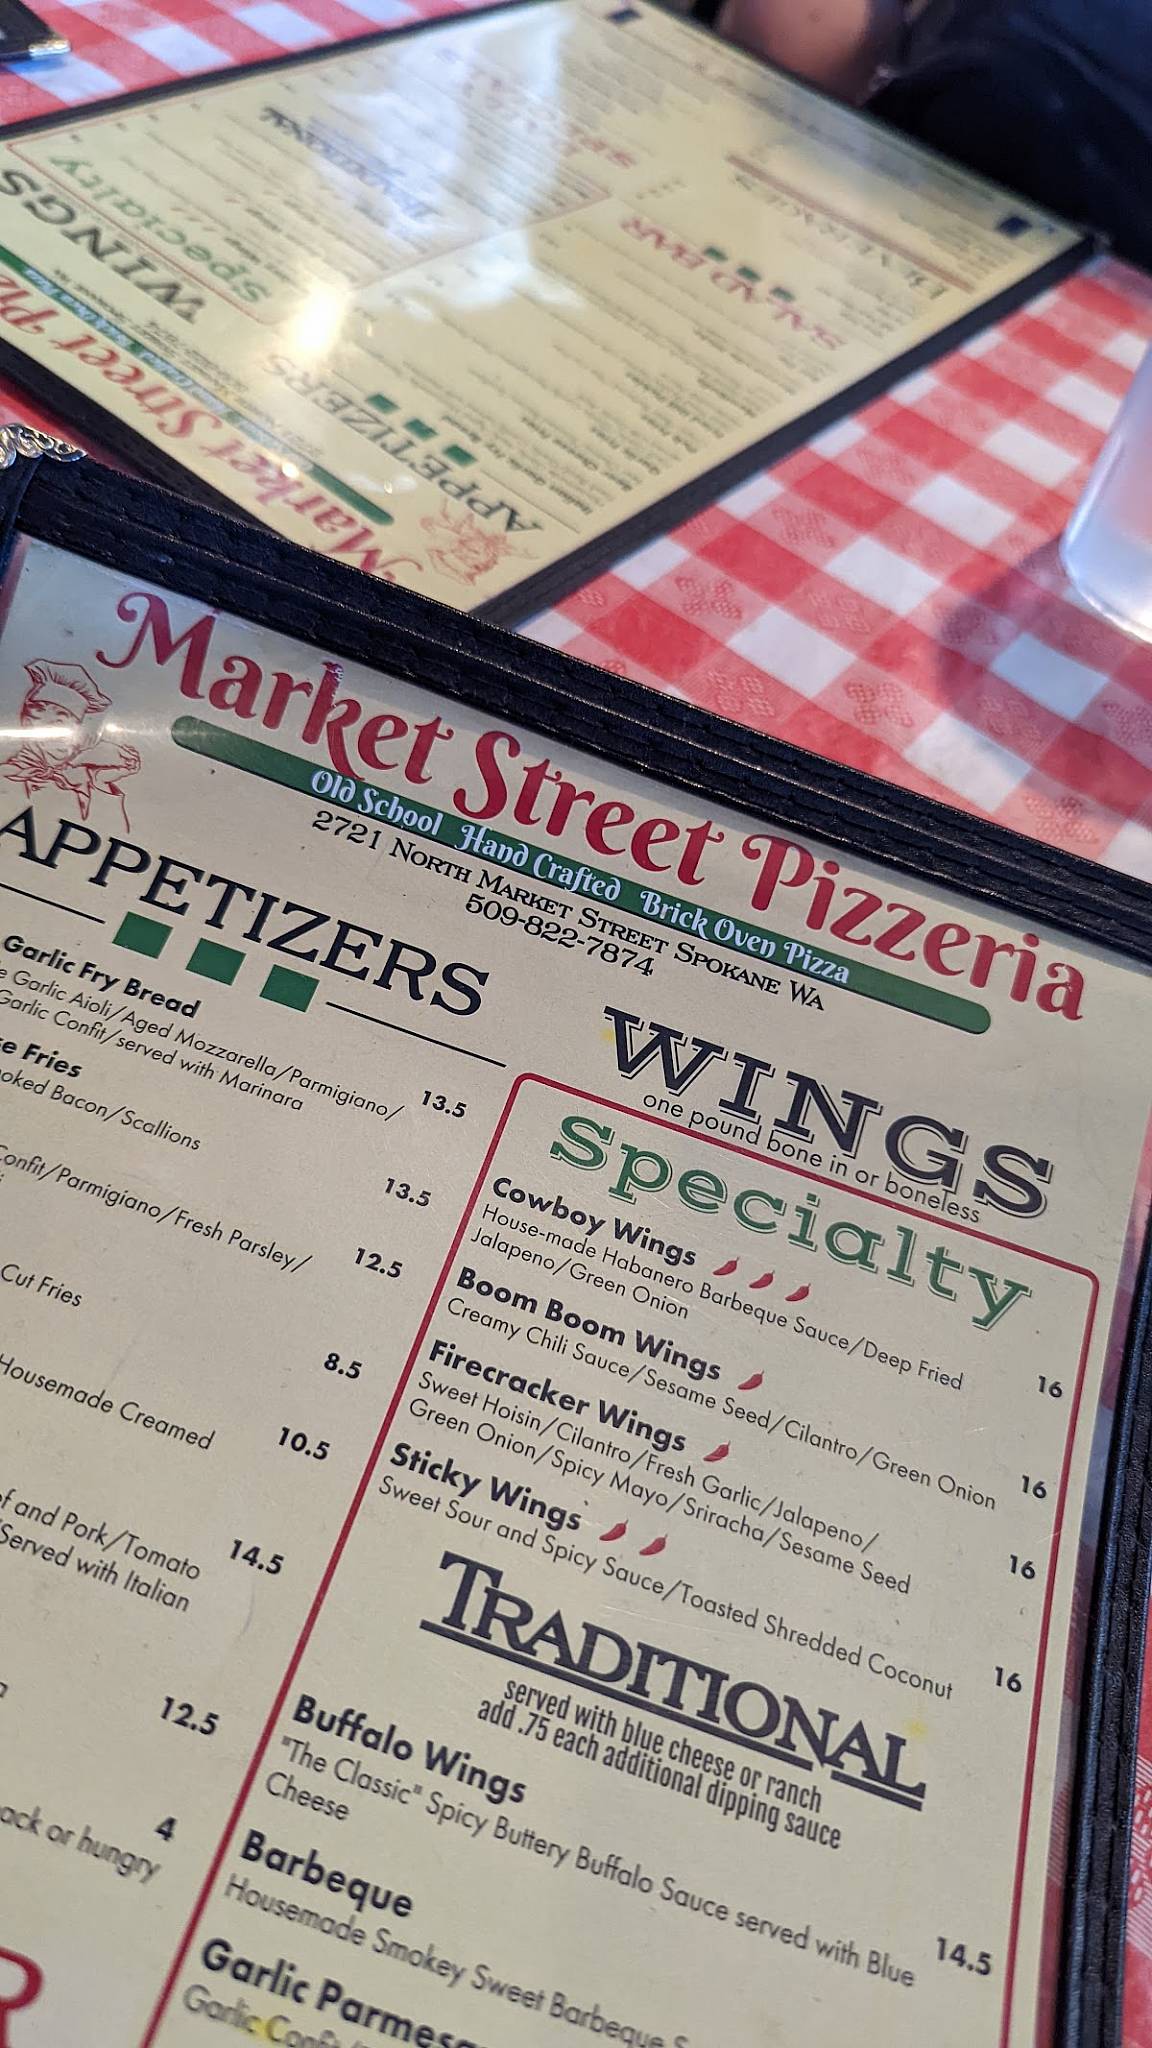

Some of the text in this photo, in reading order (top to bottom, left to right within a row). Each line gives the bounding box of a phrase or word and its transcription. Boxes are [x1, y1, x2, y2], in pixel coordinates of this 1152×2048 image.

[0, 167, 207, 324] WINGS
[48, 153, 272, 306] Specialty
[50, 334, 223, 440] Street
[264, 354, 545, 533] APPETIZERS
[206, 428, 425, 581] Market
[96, 592, 1086, 1021] Market Street Pizzeria
[0, 806, 490, 1017] APPETIZERS
[312, 769, 851, 984] Old School Hand Crafted Brick Oven Pizza
[0, 935, 202, 1019] Garlic Fry Bread
[465, 893, 655, 978] 509-822-7874
[13, 970, 67, 1002] Garlic
[0, 989, 50, 1021] Garlic
[180, 1059, 215, 1080] with
[218, 1070, 304, 1112] Marinara
[0, 1069, 51, 1096] oked
[21, 1043, 83, 1079] Fries
[422, 1090, 467, 1119] 13.5
[603, 1005, 1055, 1219] WINGS
[385, 1178, 432, 1208] 13.5
[643, 1094, 980, 1223] one pound bone in or boneless
[355, 1248, 404, 1279] 12.5
[493, 1177, 697, 1267] Cowboy Wings
[549, 1115, 1031, 1330] Specialty
[0, 1264, 83, 1308] Cut Fries
[456, 1266, 721, 1382] Boom Boom Wings
[482, 1204, 597, 1259] House-made
[602, 1247, 694, 1294] Habanero
[699, 1282, 788, 1328] Barbeque
[918, 1360, 964, 1391] Fried
[632, 1286, 689, 1320] Onion
[0, 1353, 216, 1451] Housemade Creamed
[324, 1353, 363, 1380] 8.5
[418, 1371, 479, 1408] Sweet
[429, 1339, 687, 1453] Firecracker Wings
[447, 1298, 522, 1342] Creamy
[526, 1327, 569, 1356] Chili
[938, 1475, 996, 1511] Onion
[1038, 1376, 1064, 1399] 16
[278, 1427, 331, 1461] 10.5
[390, 1443, 582, 1532] Sticky Wings
[1022, 1475, 1048, 1500] 16
[14, 1502, 62, 1528] and
[409, 1398, 470, 1436] Green
[860, 1561, 912, 1595] Seed
[77, 1558, 119, 1586] with
[123, 1571, 190, 1613] Italian
[230, 1539, 285, 1576] 14.5
[379, 1475, 441, 1514] Sweet
[445, 1500, 494, 1532] Sour
[496, 1525, 539, 1549] and
[542, 1535, 598, 1575] Spicy
[764, 1615, 863, 1668] Shredded
[868, 1653, 953, 1701] Coconut
[1010, 1554, 1036, 1581] 16
[161, 1696, 220, 1737] 12.5
[438, 1551, 926, 1800] TRADITIONAL
[995, 1666, 1023, 1694] 16
[292, 1694, 527, 1806] Buffalo Wings
[477, 1700, 842, 1851] add .75 each additional dipping sauce
[504, 1680, 822, 1815] served with blue cheese or ranch
[155, 1818, 177, 1843] 4
[266, 1772, 350, 1822] Cheese
[46, 1825, 76, 1847] or
[76, 1826, 161, 1885] hungry
[240, 1829, 413, 1919] Barbeque
[425, 1791, 489, 1838] Spicy
[493, 1816, 572, 1868] Buttery
[575, 1846, 654, 1895] Buffalo
[660, 1877, 729, 1922] Sauce
[735, 1912, 811, 1951] served
[816, 1940, 860, 1969] with
[867, 1950, 915, 1989] Blue
[201, 1939, 311, 2005] Garlic
[224, 1874, 367, 1947] Housemade
[372, 1928, 467, 1988] Smokey
[471, 1964, 546, 2012] Sweet
[937, 1937, 992, 1977] 14.5
